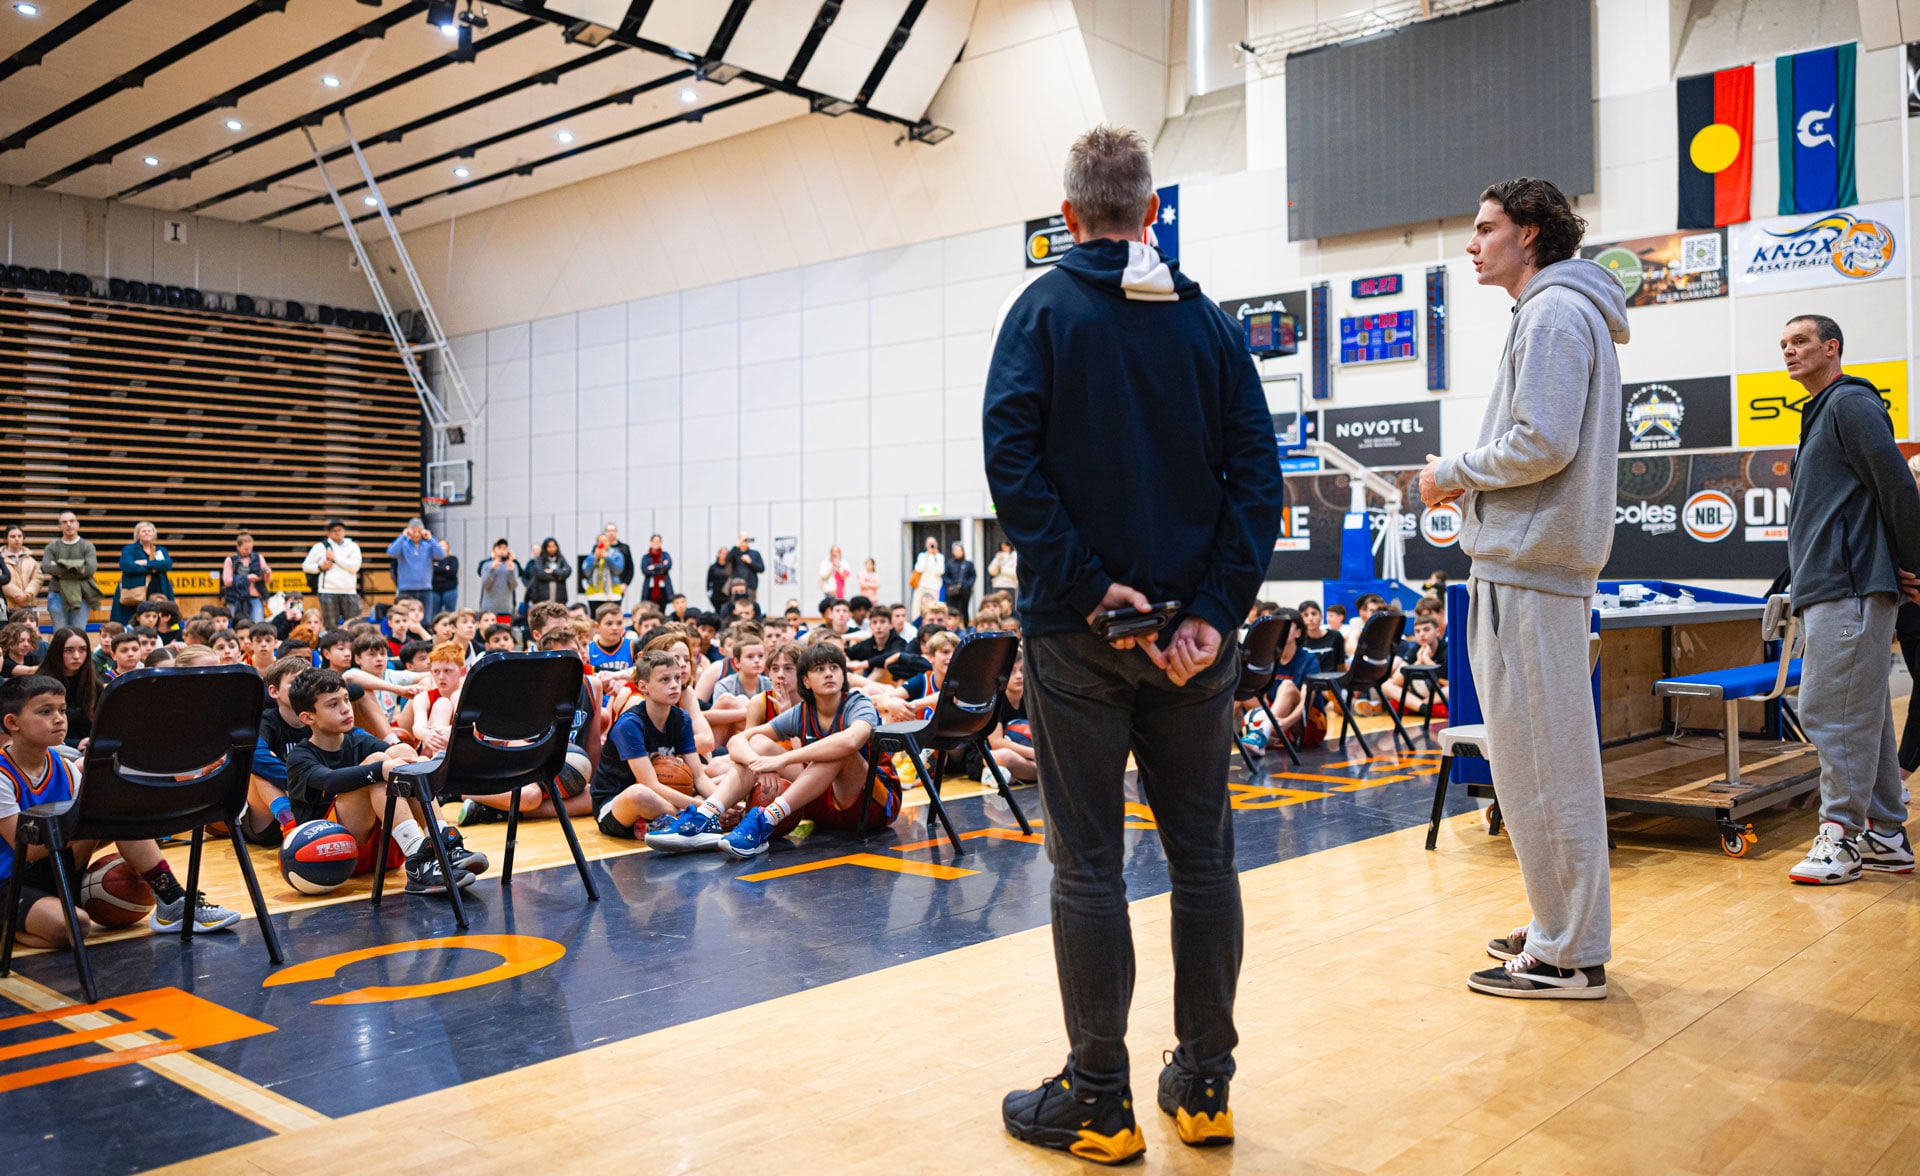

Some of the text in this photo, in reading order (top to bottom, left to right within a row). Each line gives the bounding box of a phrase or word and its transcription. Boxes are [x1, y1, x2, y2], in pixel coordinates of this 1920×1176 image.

[1752, 237, 1837, 263] KNOX
[1746, 255, 1833, 274] BASKETBALL
[1336, 418, 1424, 438] NOVOTEL
[1615, 501, 1677, 524] coles
[1695, 506, 1724, 526] NBL
[1431, 515, 1453, 532] NBL
